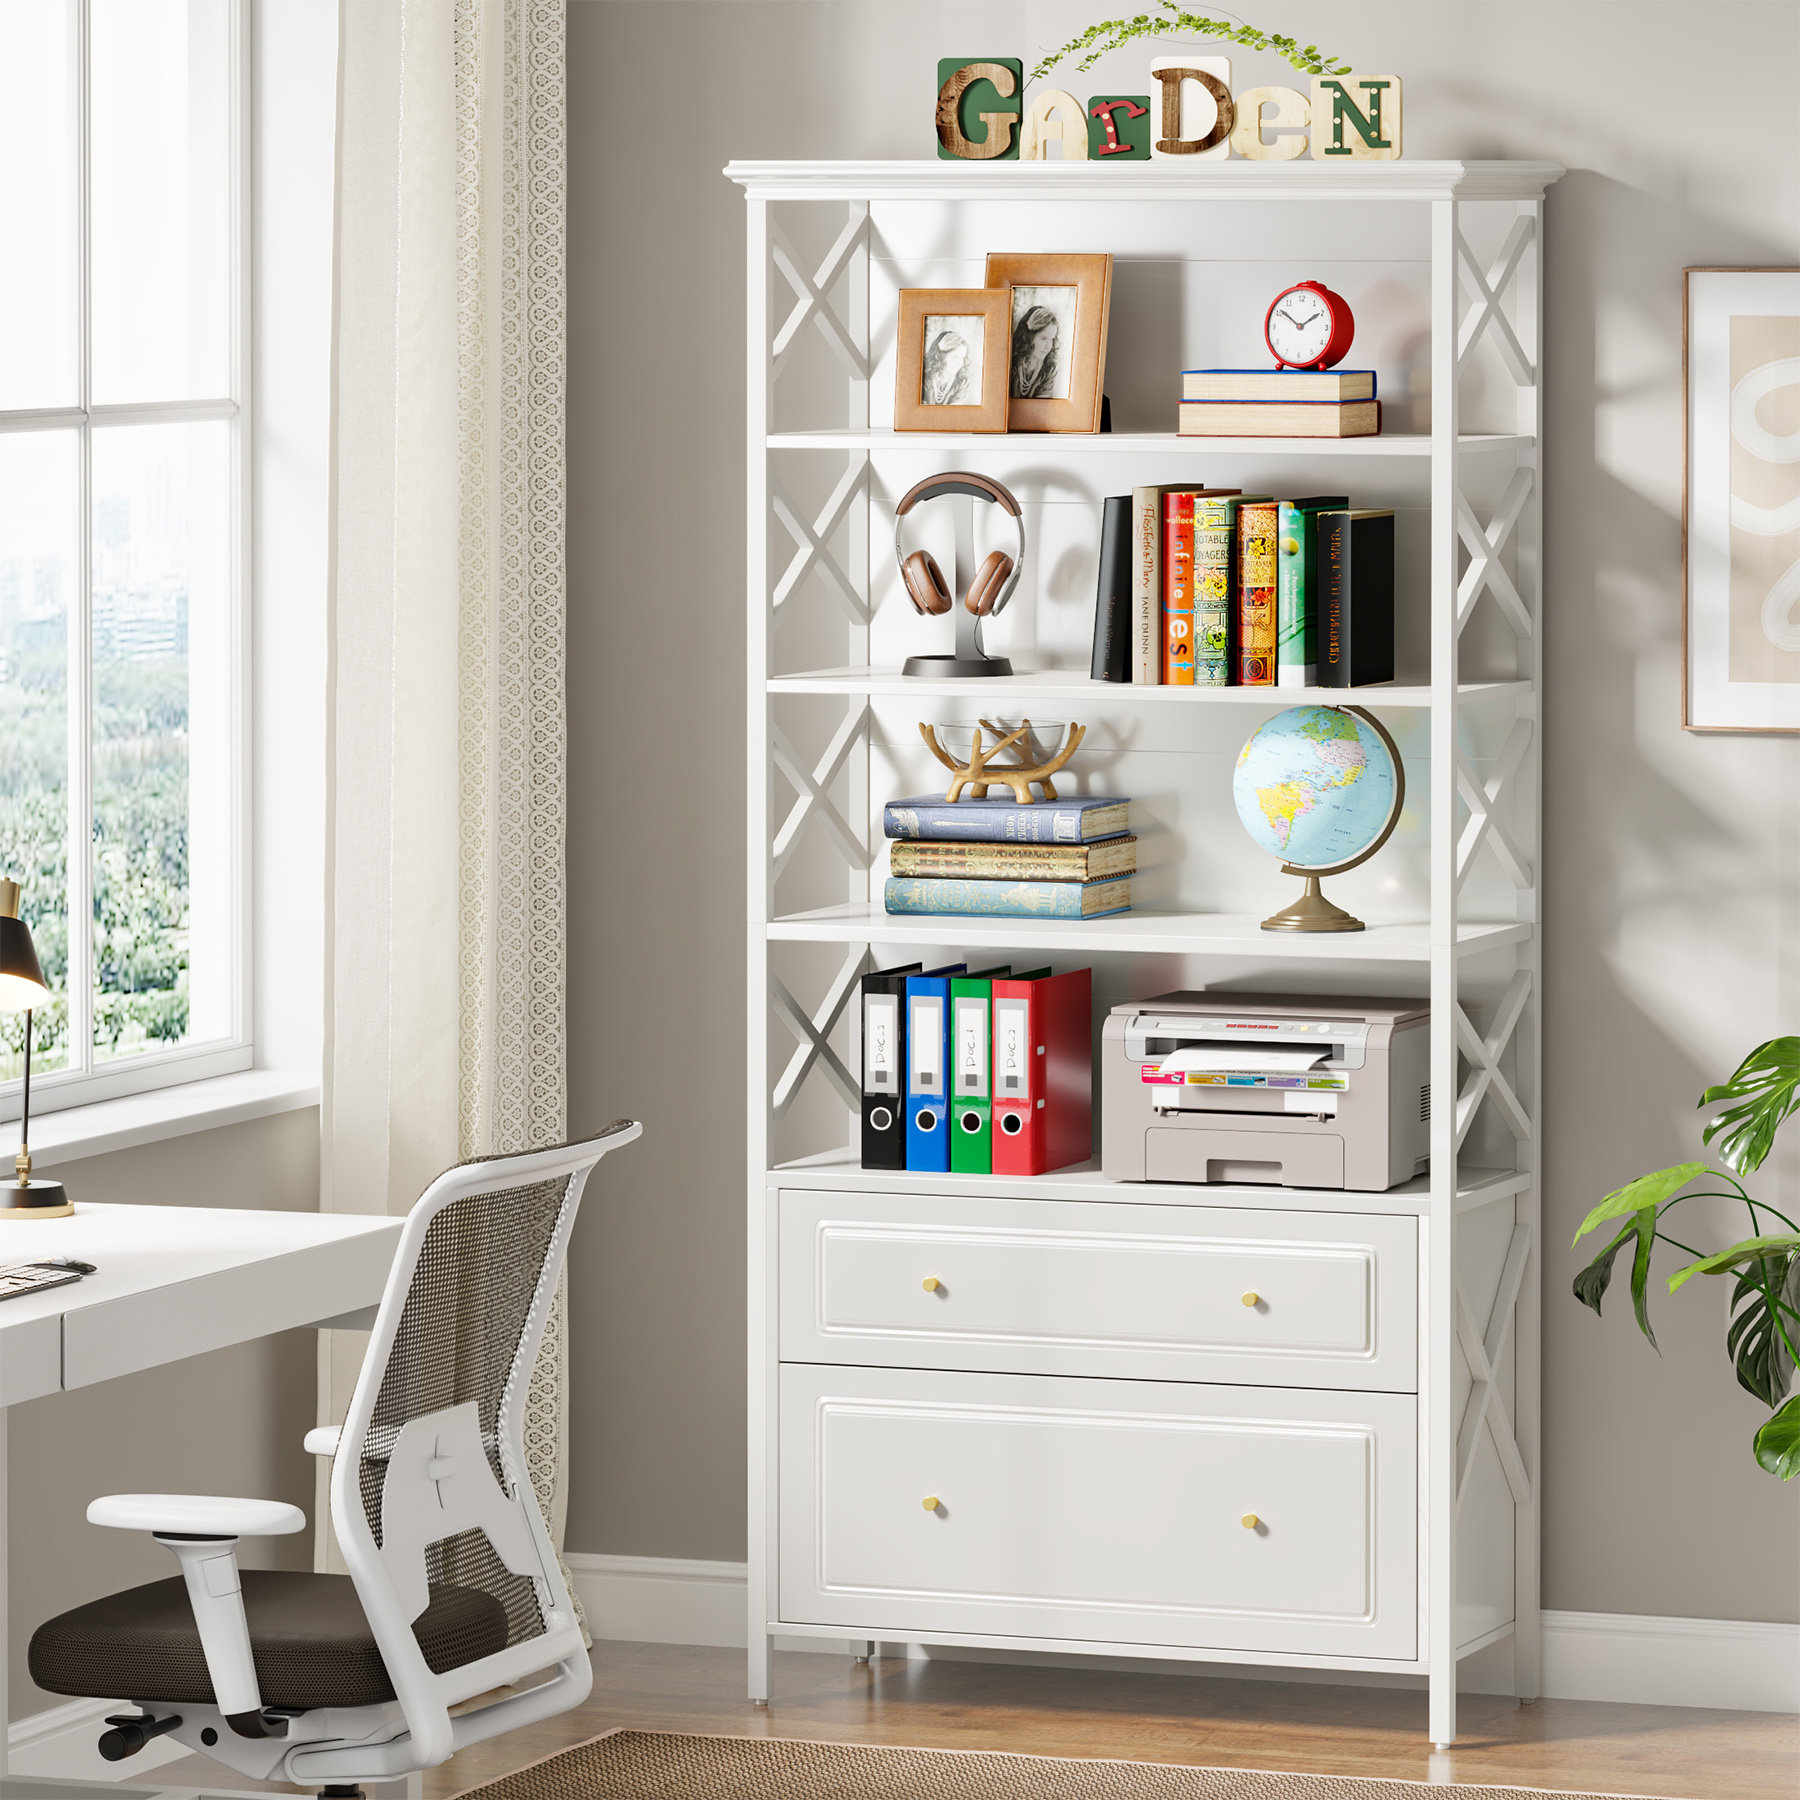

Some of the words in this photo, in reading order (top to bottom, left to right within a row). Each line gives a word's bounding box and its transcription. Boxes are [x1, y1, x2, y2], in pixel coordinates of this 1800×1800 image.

[1286, 299, 1293, 307] 11
[1142, 558, 1155, 589] Mary
[1173, 534, 1191, 600] infinite
[1140, 596, 1150, 621] JANE
[1141, 622, 1150, 655] DUNN
[1162, 600, 1195, 672] jest
[1006, 815, 1015, 837] WORK
